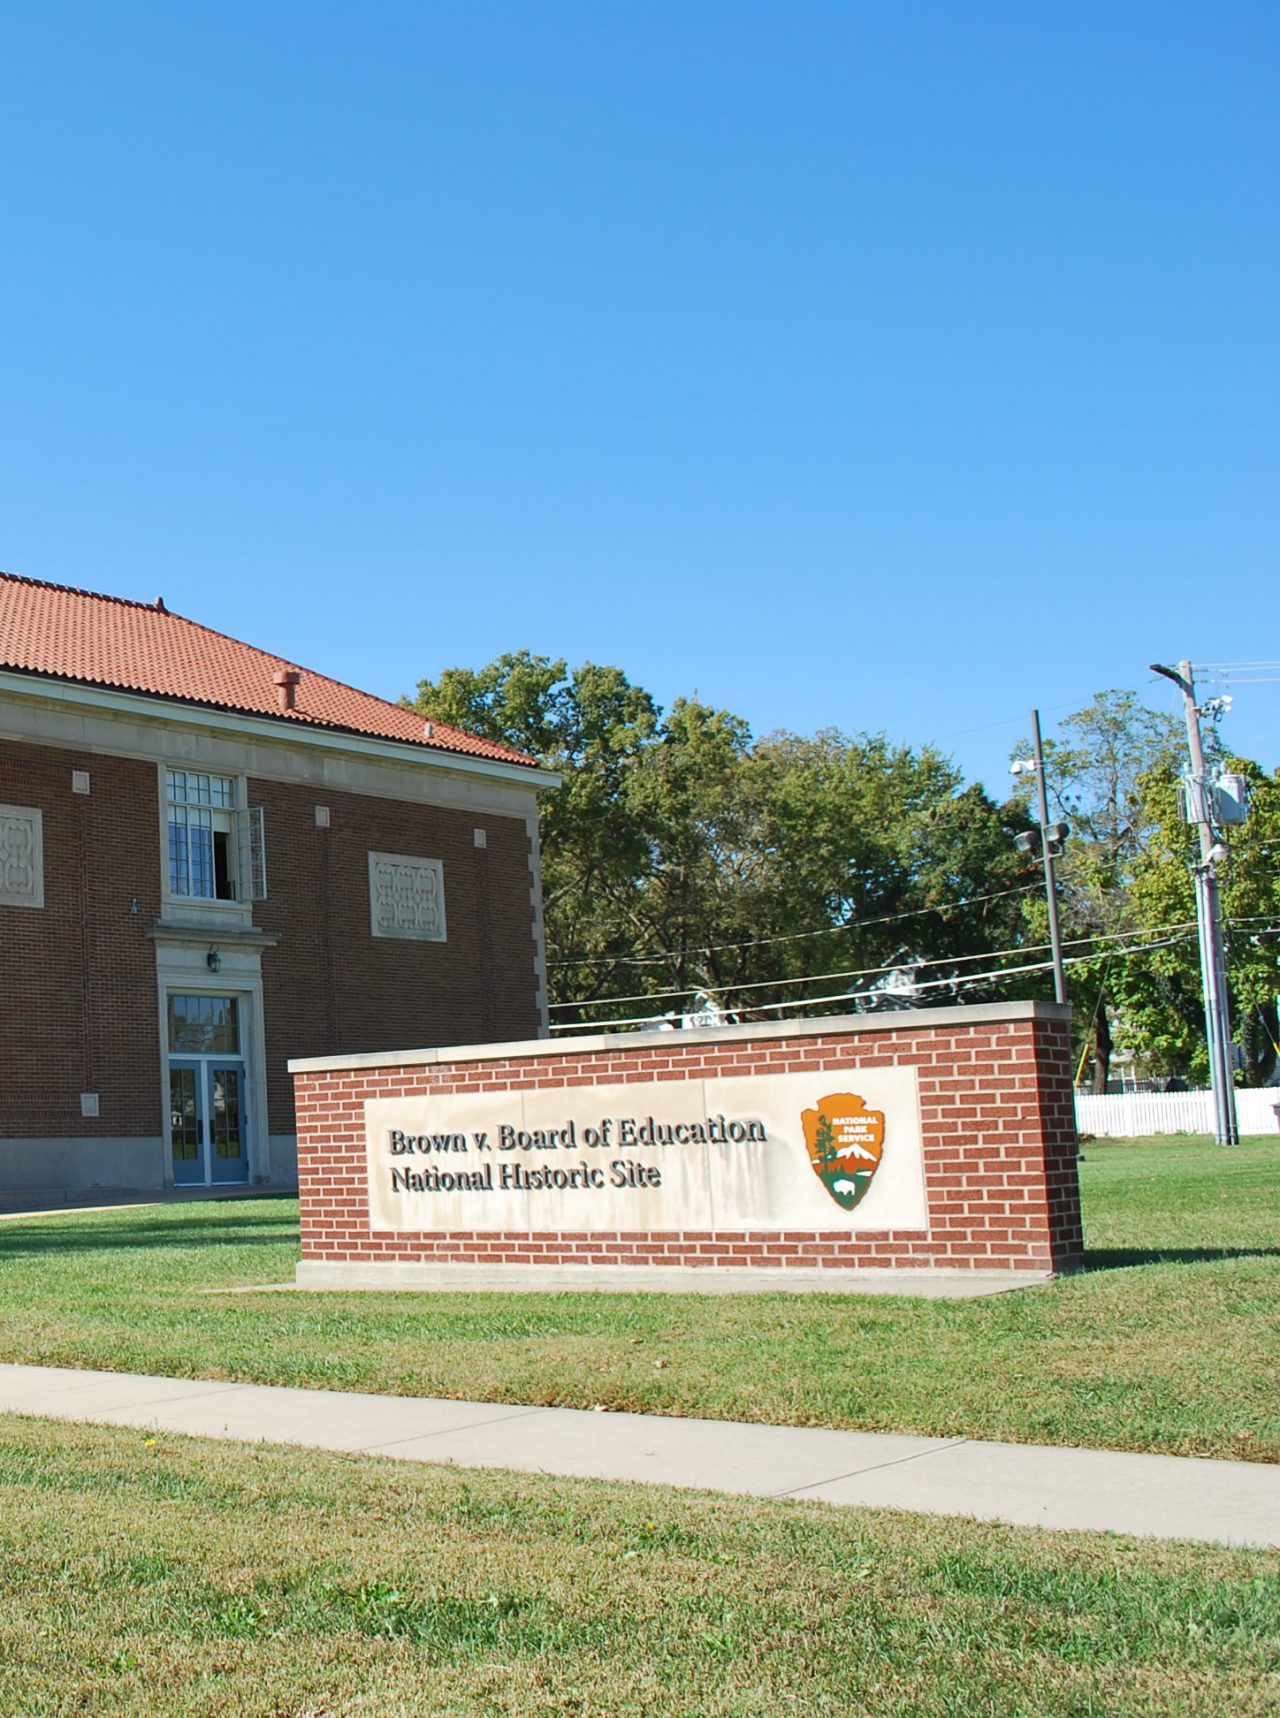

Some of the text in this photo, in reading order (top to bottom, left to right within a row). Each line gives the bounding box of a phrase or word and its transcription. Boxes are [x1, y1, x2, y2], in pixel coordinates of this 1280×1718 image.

[832, 1116, 878, 1126] NATIONAL
[388, 1113, 768, 1156] Brown v. Board of Education
[843, 1125, 868, 1134] PARK
[837, 1133, 875, 1143] SERVICE
[389, 1158, 662, 1193] National Historic Site
